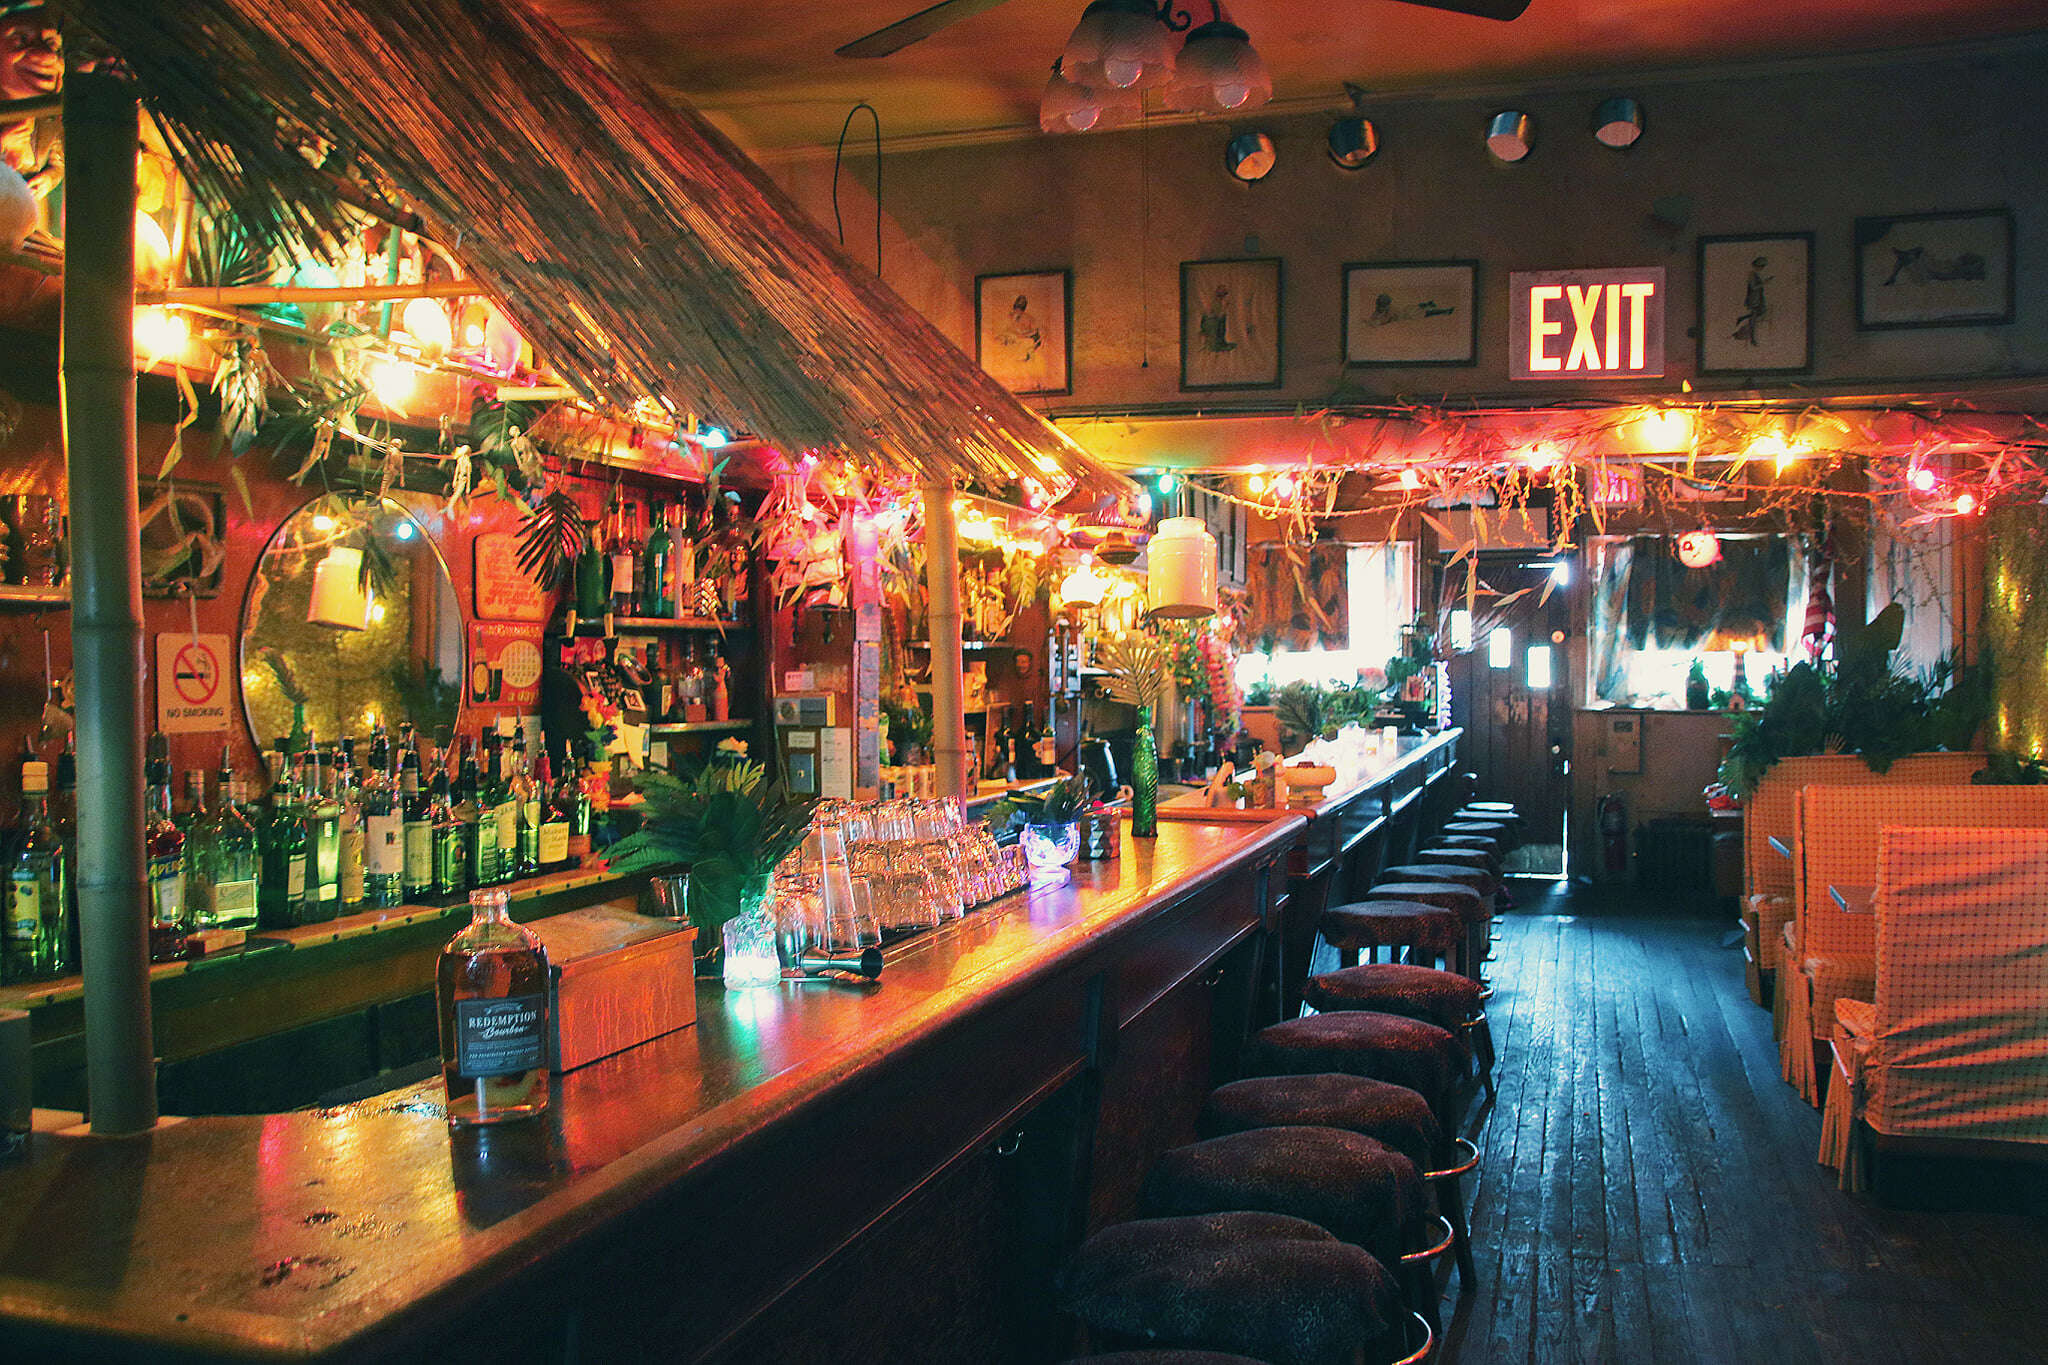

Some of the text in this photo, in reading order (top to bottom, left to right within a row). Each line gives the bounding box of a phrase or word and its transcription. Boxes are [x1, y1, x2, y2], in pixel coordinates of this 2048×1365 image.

[1529, 283, 1655, 371] EXIT
[166, 707, 225, 718] NO SMOKING
[468, 1010, 537, 1029] REDEMPTION
[482, 1024, 529, 1040] Bourbon
